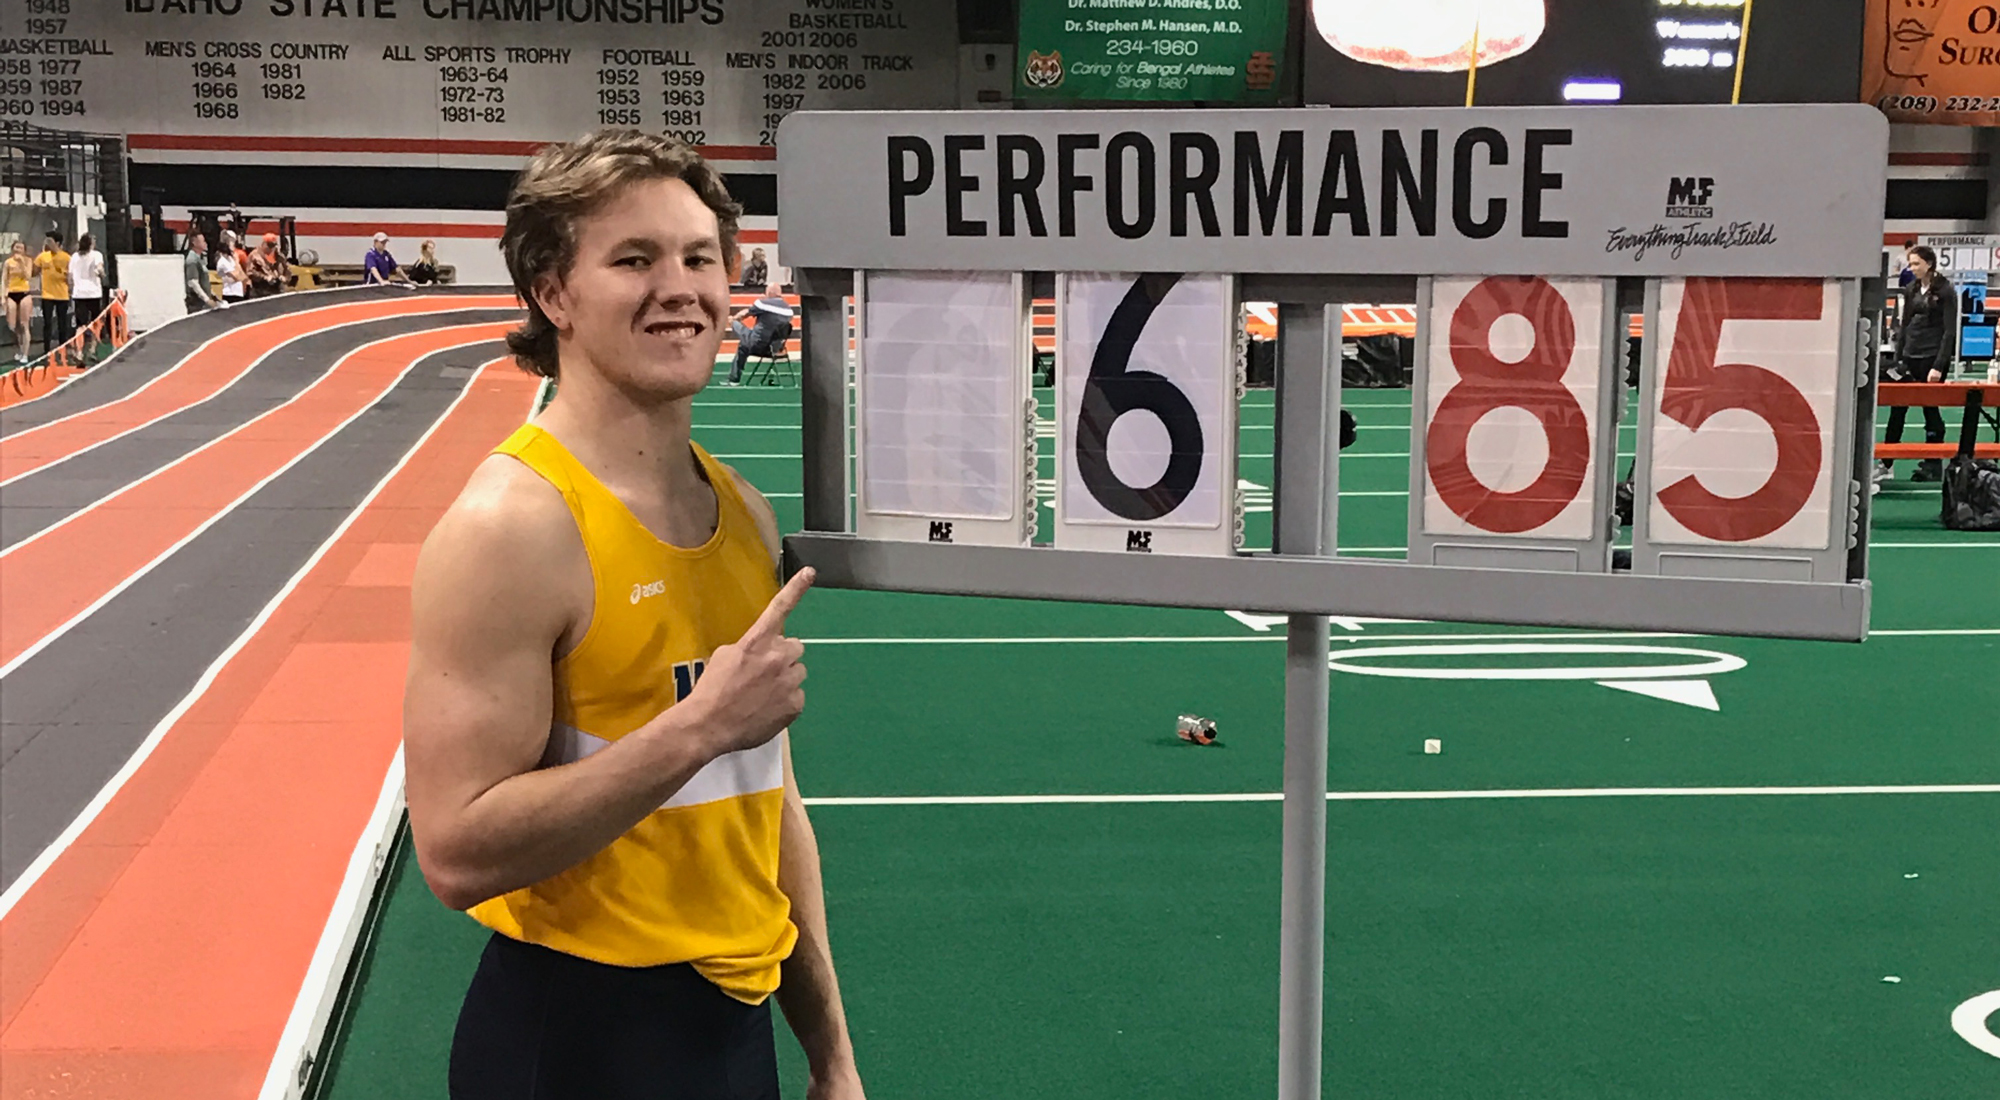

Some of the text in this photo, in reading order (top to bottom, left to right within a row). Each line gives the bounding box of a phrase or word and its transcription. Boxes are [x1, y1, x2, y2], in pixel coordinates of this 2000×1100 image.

[26, 0, 70, 14] 1948
[423, 0, 725, 25] CHAMPIONSHIPS
[25, 18, 67, 34] 1957
[789, 13, 907, 29] BASKETBALL
[1065, 19, 1242, 34] Dr. Stephen M. Hansen, M.D.
[761, 31, 858, 48] 2001 2006
[1106, 39, 1198, 56] 234-1960
[145, 41, 349, 60] MEN'S CROSS COUNTRY
[382, 45, 572, 64] ALL SPORTS TROPHY
[603, 49, 696, 66] FOOTBALL
[0, 59, 81, 75] 958 1977
[192, 62, 302, 79] 1964 1981
[726, 53, 914, 71] MEN'S INDOOR TRACK
[1070, 61, 1111, 77] Caring
[1116, 61, 1134, 74] for
[1136, 61, 1182, 76] Bengal
[439, 66, 508, 83] 1963-64
[596, 69, 705, 86] 1952 1959
[763, 74, 866, 90] 1982 2006
[0, 79, 82, 95] 959 1987
[192, 82, 306, 100] 1966 1982
[440, 86, 504, 103] 1972-73
[597, 89, 705, 106] 1953 1963
[763, 94, 804, 109] 1997
[1879, 95, 1937, 114] (208)
[0, 99, 86, 116] 960 1994
[193, 102, 239, 119] 1968
[441, 107, 505, 123] 1981-82
[598, 109, 701, 125] 1955 1981
[886, 126, 1573, 240] PERFORMANCE
[1666, 206, 1712, 217] ATHLETIC
[1927, 236, 1986, 246] PERFORMANCE
[1939, 247, 1951, 267] 5
[1076, 272, 1204, 521] 6
[641, 579, 666, 598] asics
